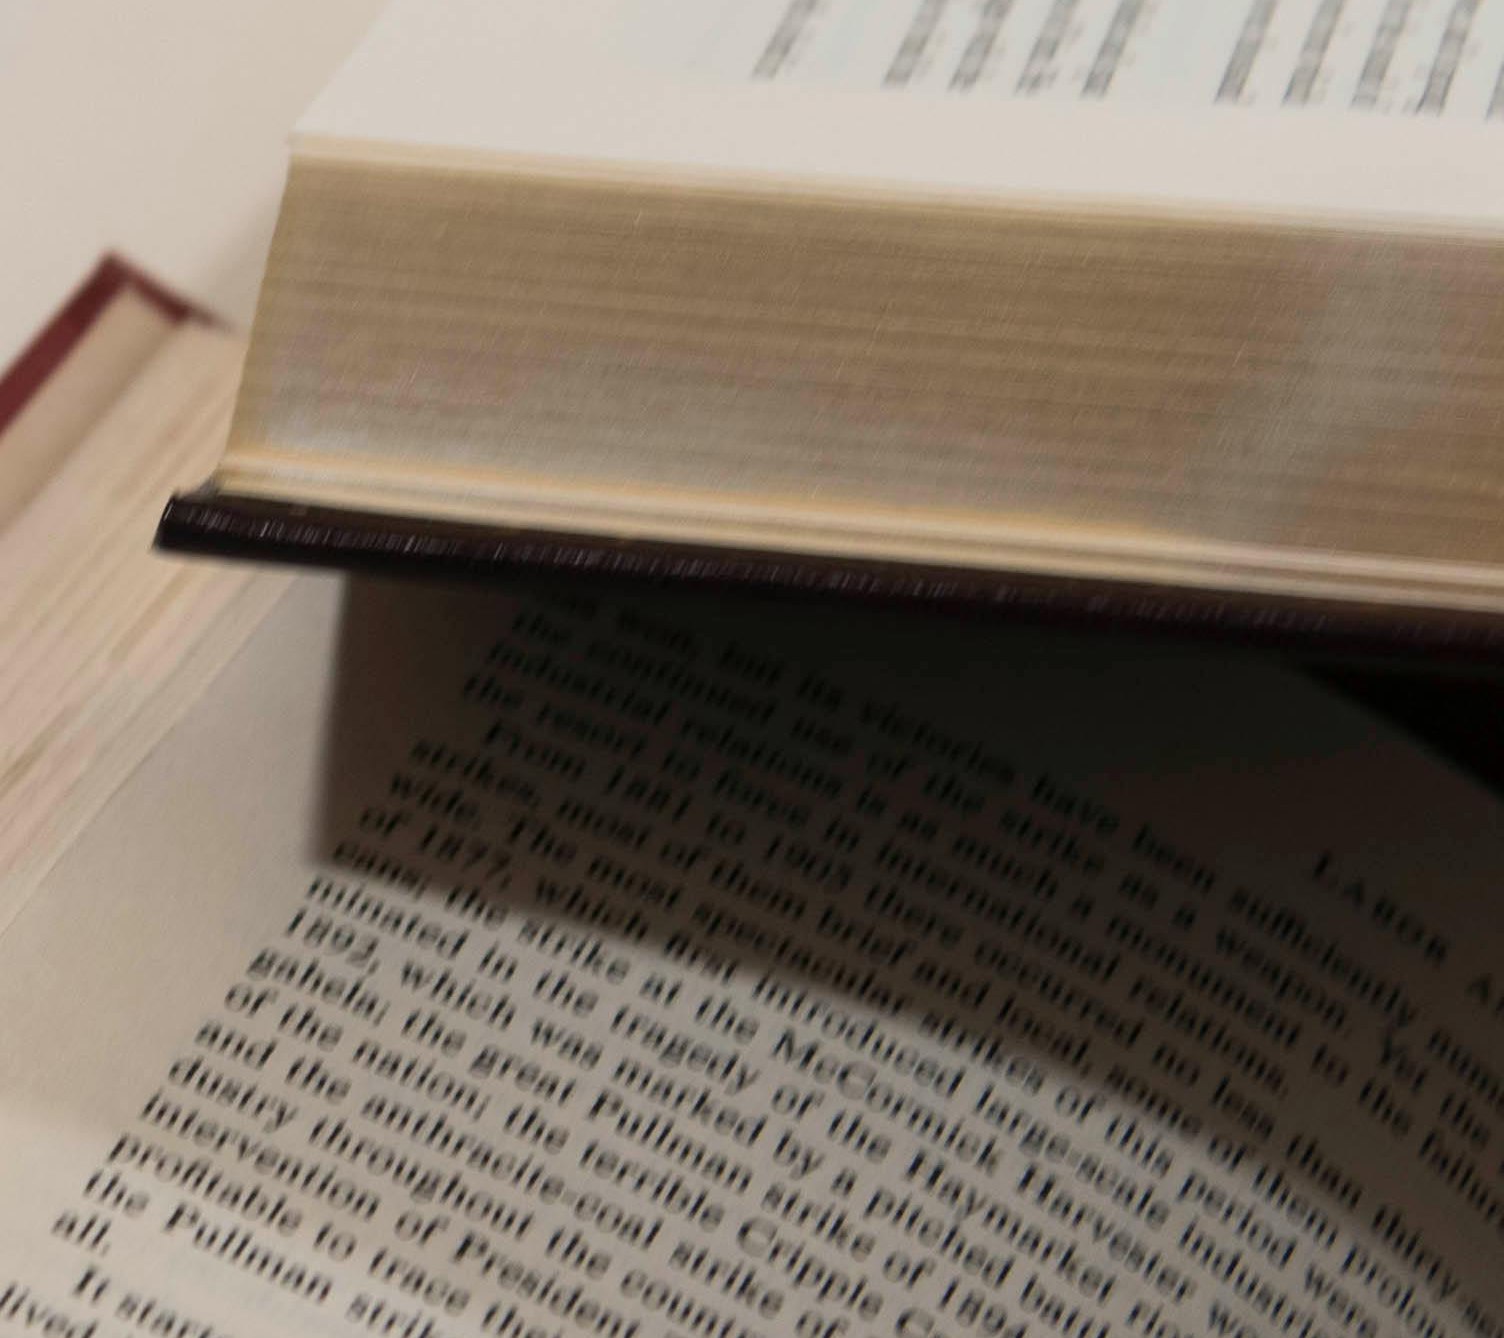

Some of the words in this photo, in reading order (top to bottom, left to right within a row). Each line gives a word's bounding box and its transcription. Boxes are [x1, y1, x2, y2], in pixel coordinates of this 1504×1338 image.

[81, 1168, 151, 1216] the
[161, 1199, 335, 1306] Pullman
[104, 1131, 305, 1234] profitable
[311, 1220, 359, 1260] to
[366, 1245, 473, 1312] trace
[392, 1210, 452, 1249] of
[70, 1262, 113, 1307] It
